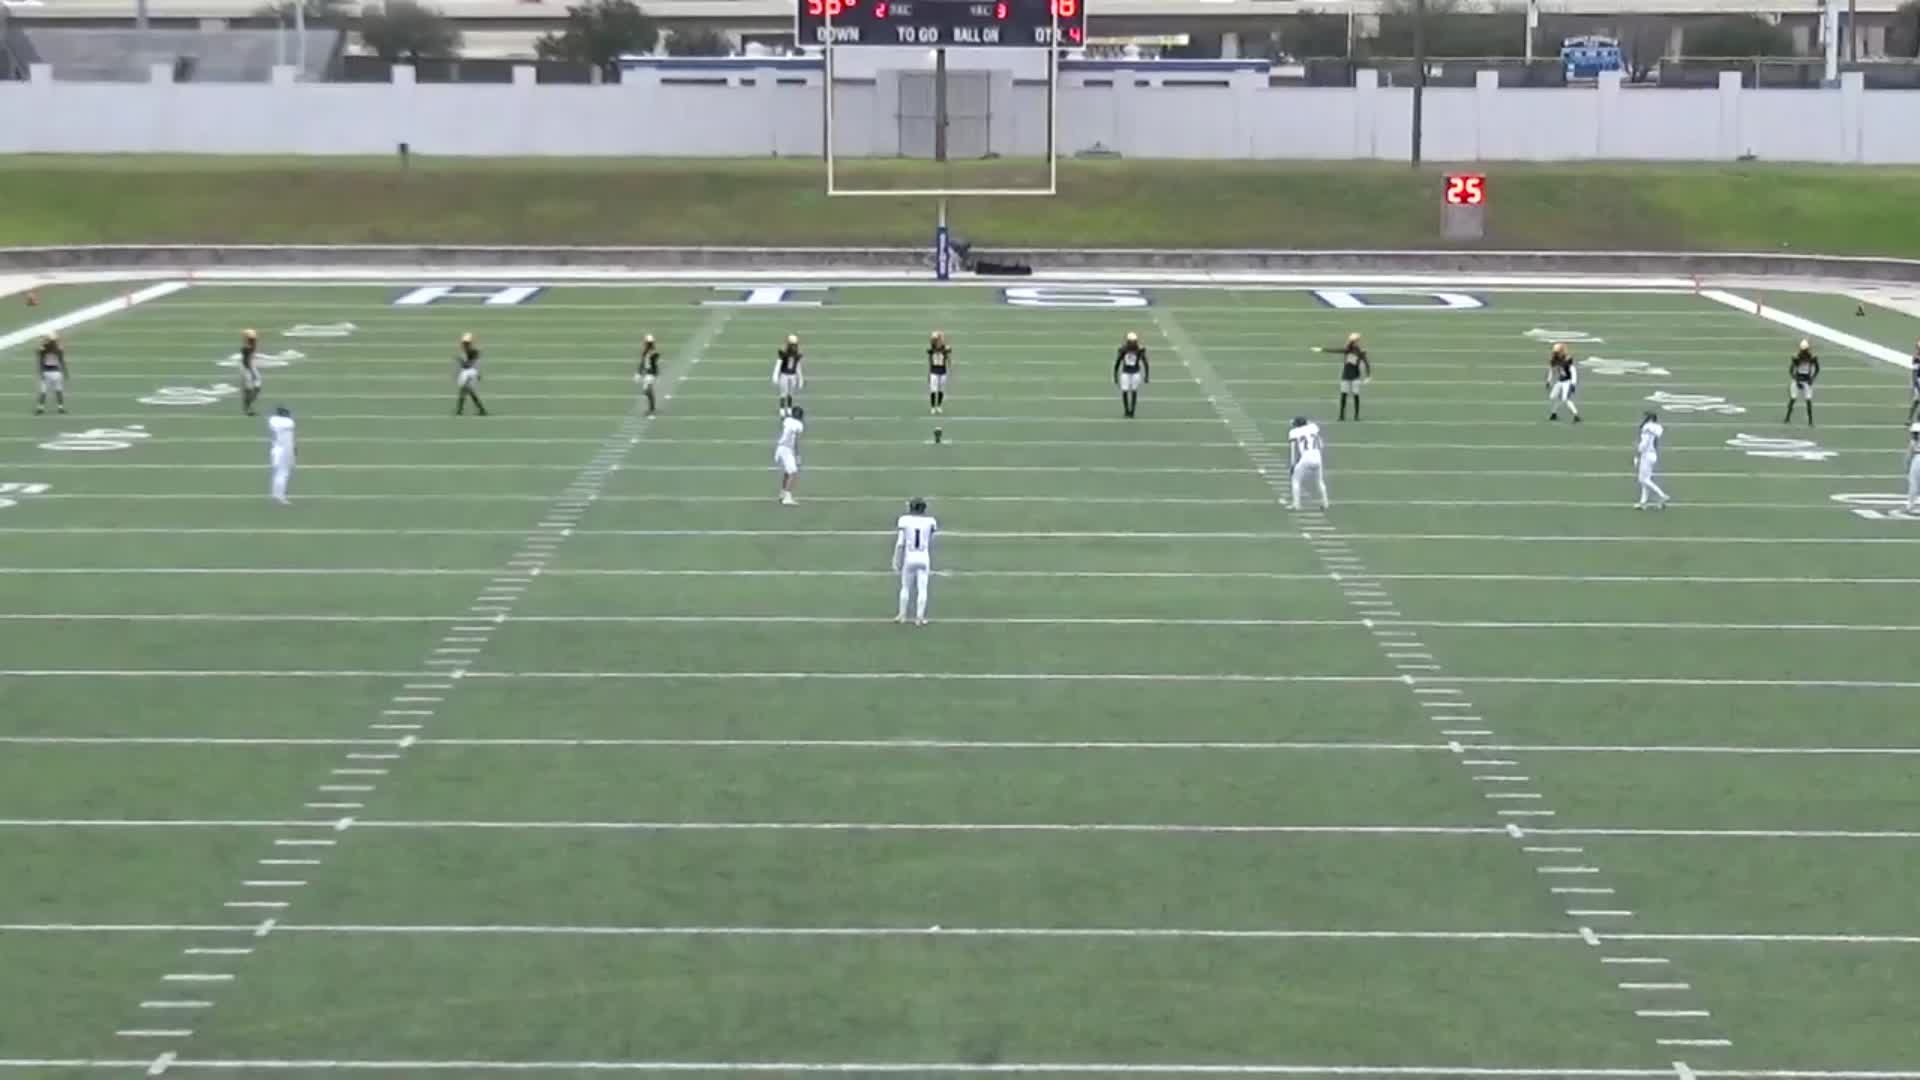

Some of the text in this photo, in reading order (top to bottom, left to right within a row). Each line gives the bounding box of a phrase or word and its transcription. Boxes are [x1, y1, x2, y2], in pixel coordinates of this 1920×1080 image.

[816, 26, 860, 42] DOWN
[896, 26, 939, 42] TO GO
[953, 26, 1000, 42] BALL ON
[1068, 27, 1081, 43] 4
[1448, 177, 1481, 204] 25
[914, 528, 921, 549] 1
